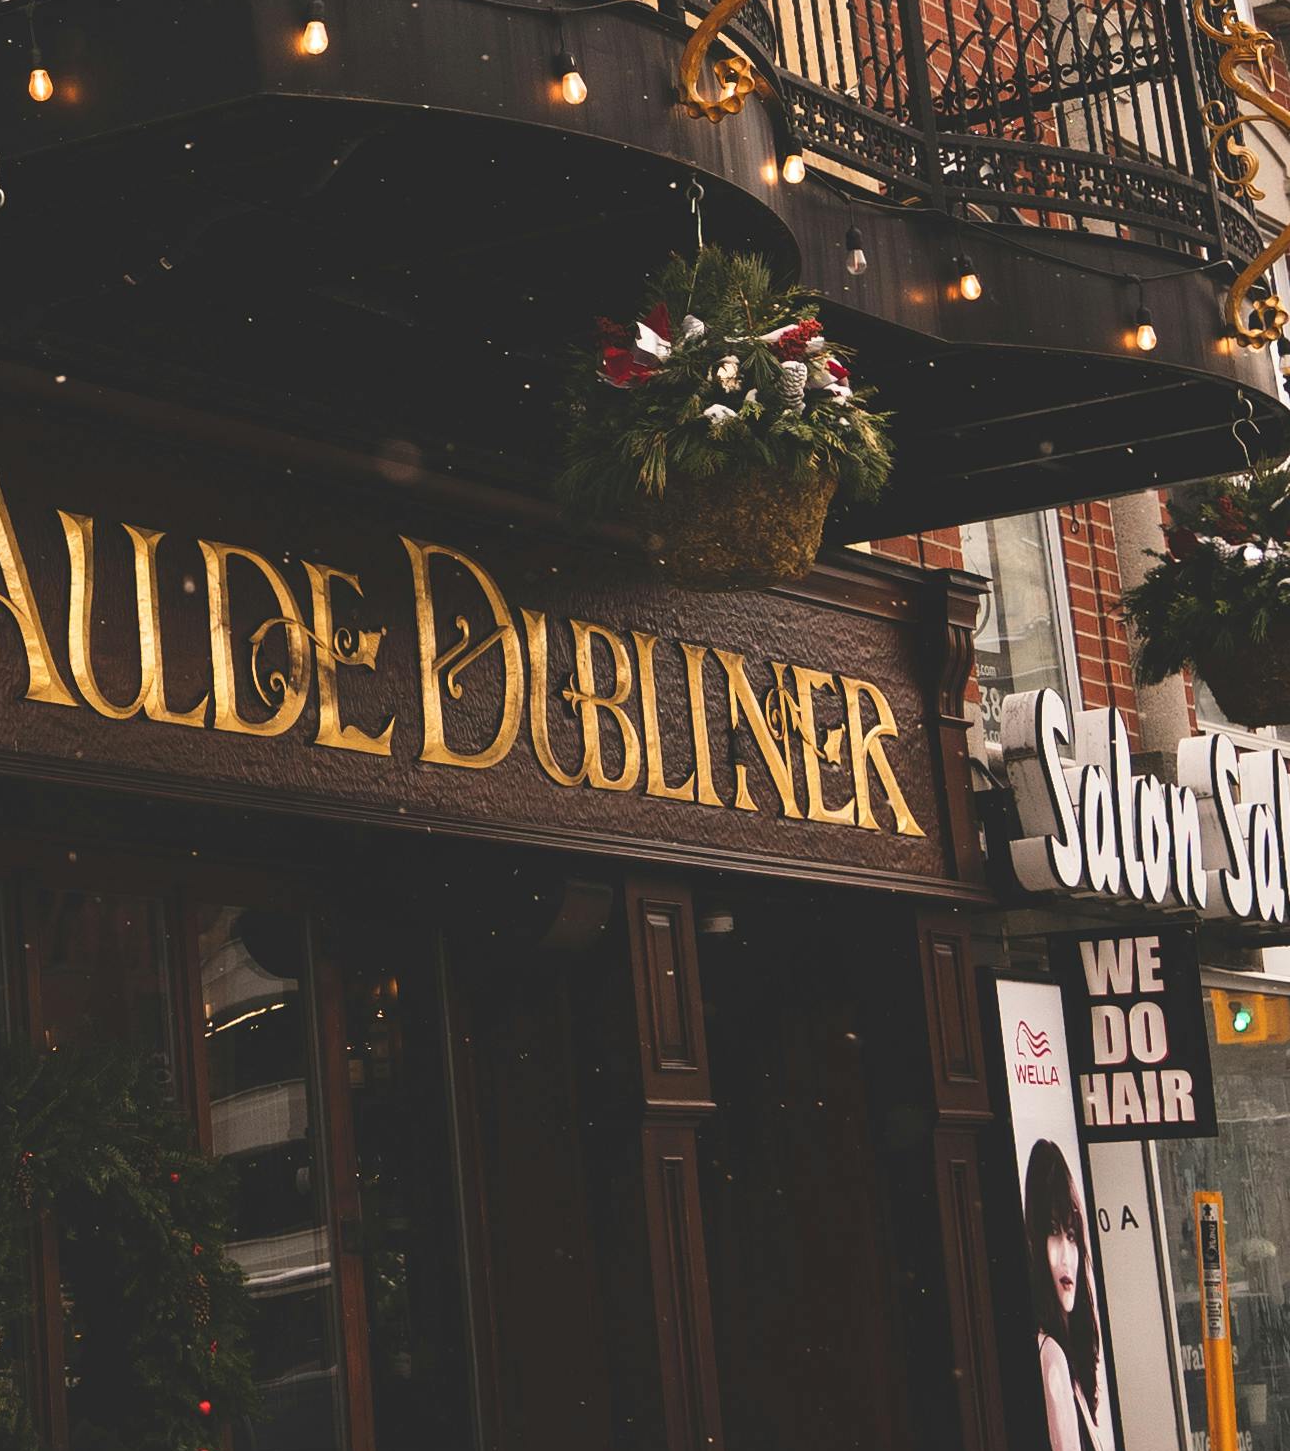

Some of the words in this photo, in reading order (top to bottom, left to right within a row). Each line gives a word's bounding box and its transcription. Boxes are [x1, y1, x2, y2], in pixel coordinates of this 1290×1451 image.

[398, 533, 927, 839] DUBLINER
[1033, 686, 1209, 910] Salon
[1079, 936, 1165, 996] WE
[1091, 1001, 1169, 1065] DO
[1014, 1063, 1061, 1086] WELLA
[1079, 1069, 1196, 1126] HAIR
